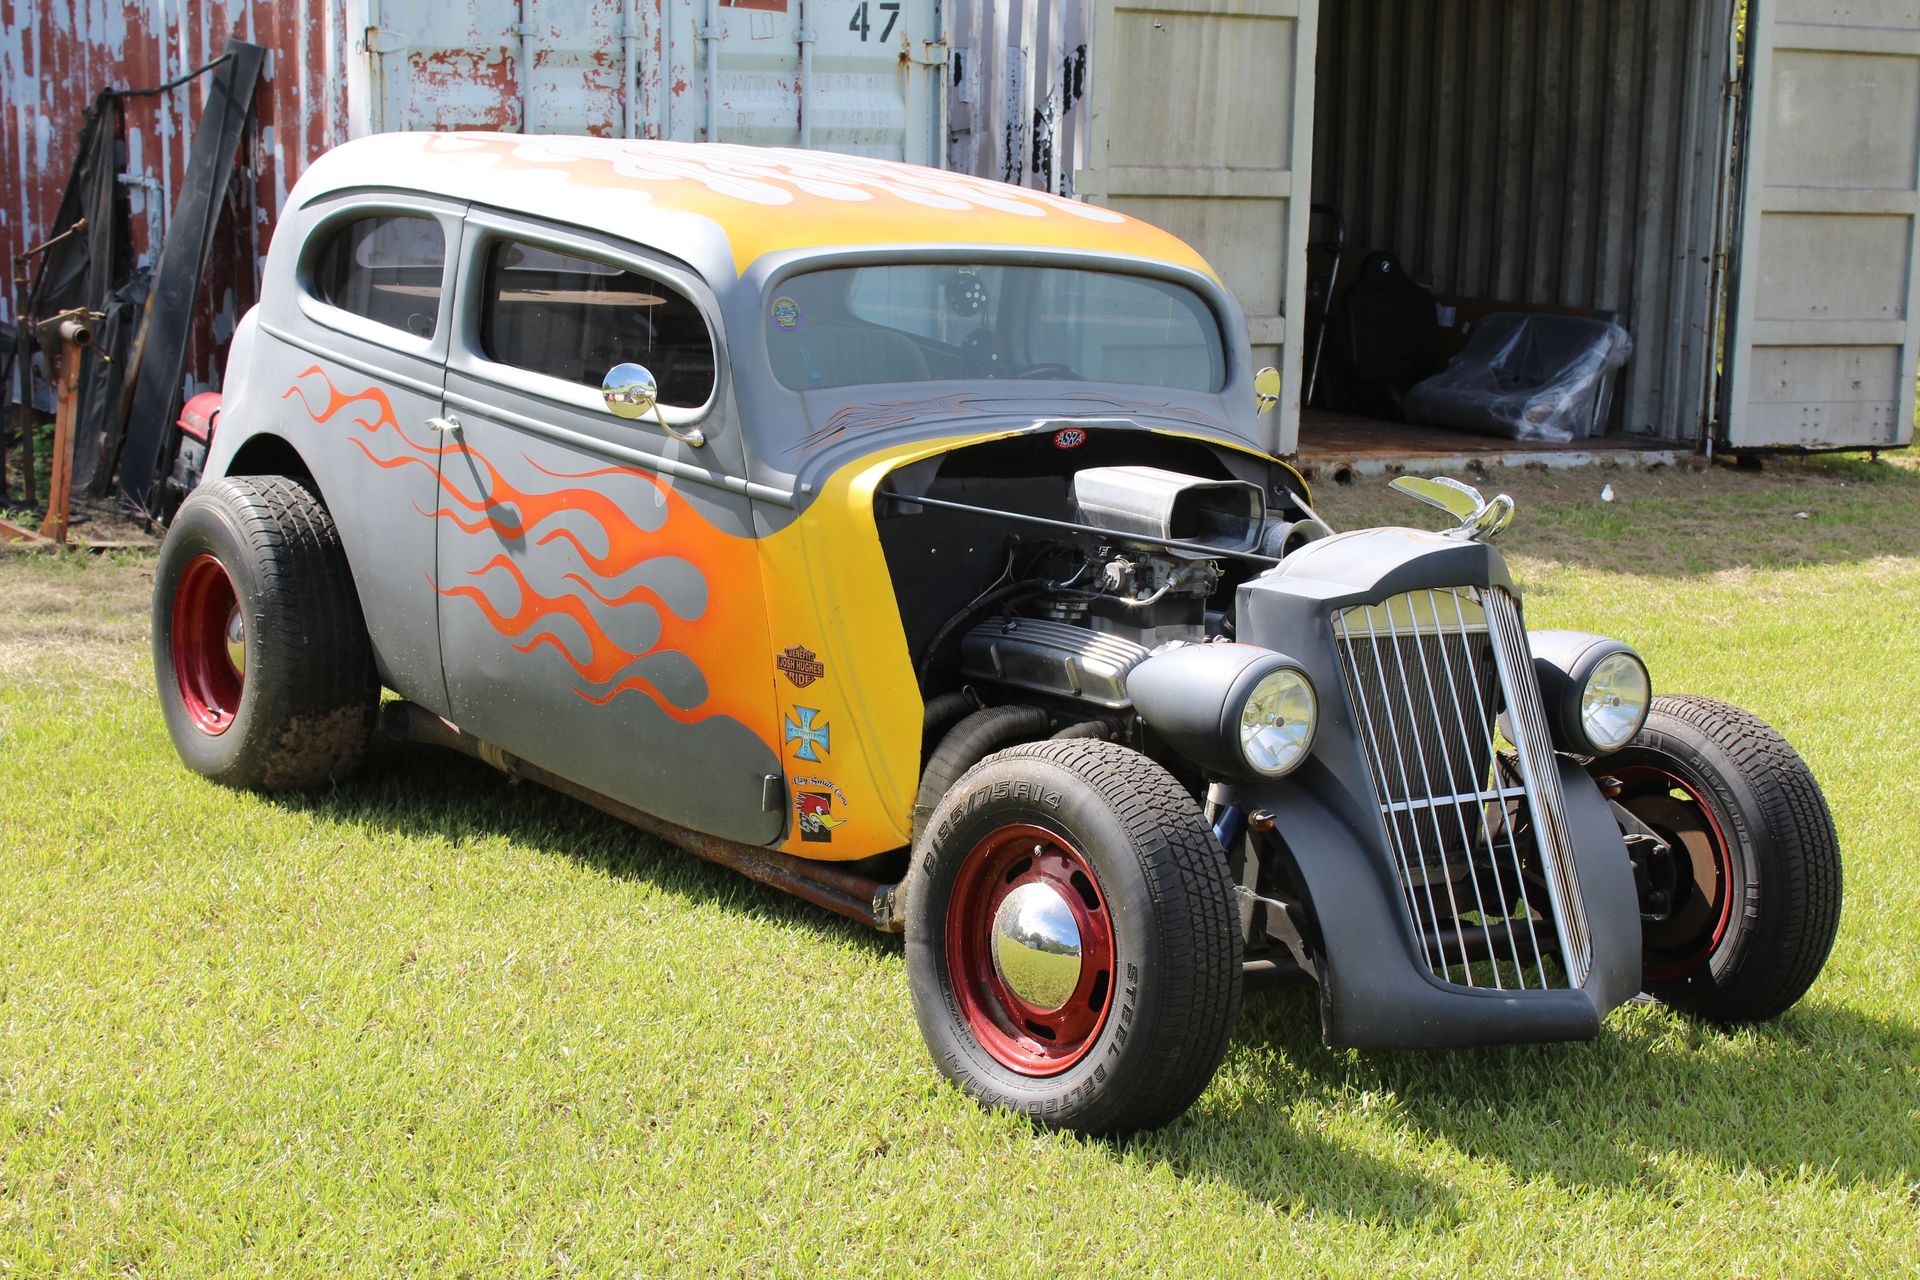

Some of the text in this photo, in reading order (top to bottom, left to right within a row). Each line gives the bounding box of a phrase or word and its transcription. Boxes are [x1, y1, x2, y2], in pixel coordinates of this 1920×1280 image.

[849, 2, 900, 43] 47
[780, 657, 821, 675] JOSH HUGHES
[789, 672, 811, 685] RIDE
[922, 780, 1063, 880] P195/75R14
[1107, 962, 1138, 1058] STEEL
[1027, 1063, 1107, 1116] BELTED
